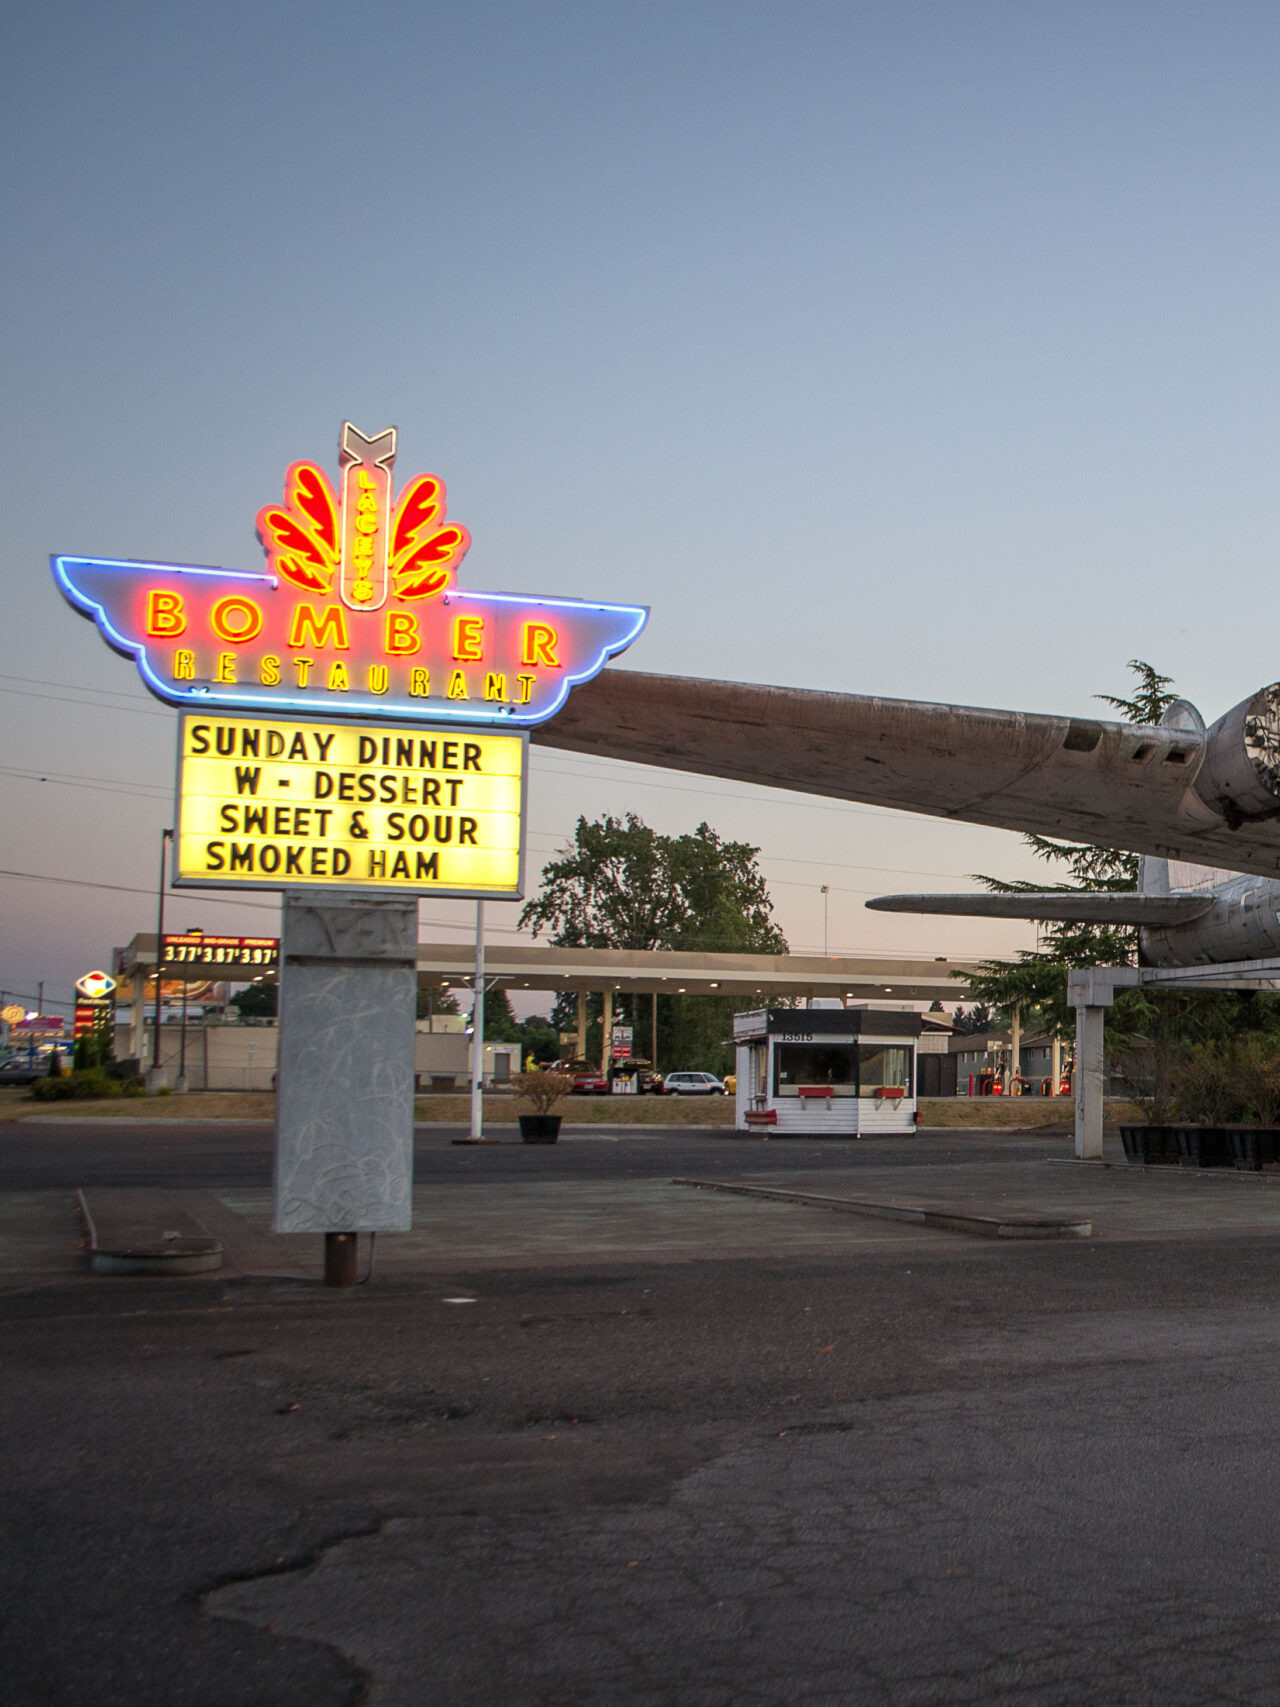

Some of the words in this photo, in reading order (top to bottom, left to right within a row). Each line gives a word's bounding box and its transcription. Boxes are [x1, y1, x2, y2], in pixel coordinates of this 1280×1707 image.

[351, 470, 378, 603] LACEYS
[147, 589, 562, 668] BOMBER
[173, 649, 536, 704] RESTAURANT
[191, 725, 336, 762] SUNDAY
[358, 735, 483, 772] DINNER
[235, 766, 262, 796] W
[220, 804, 333, 838] SWEET
[349, 810, 369, 840] &
[387, 811, 478, 845] SOUR
[206, 841, 352, 876] SMOKED
[368, 849, 440, 880] HAM
[783, 1033, 813, 1042] 13515
